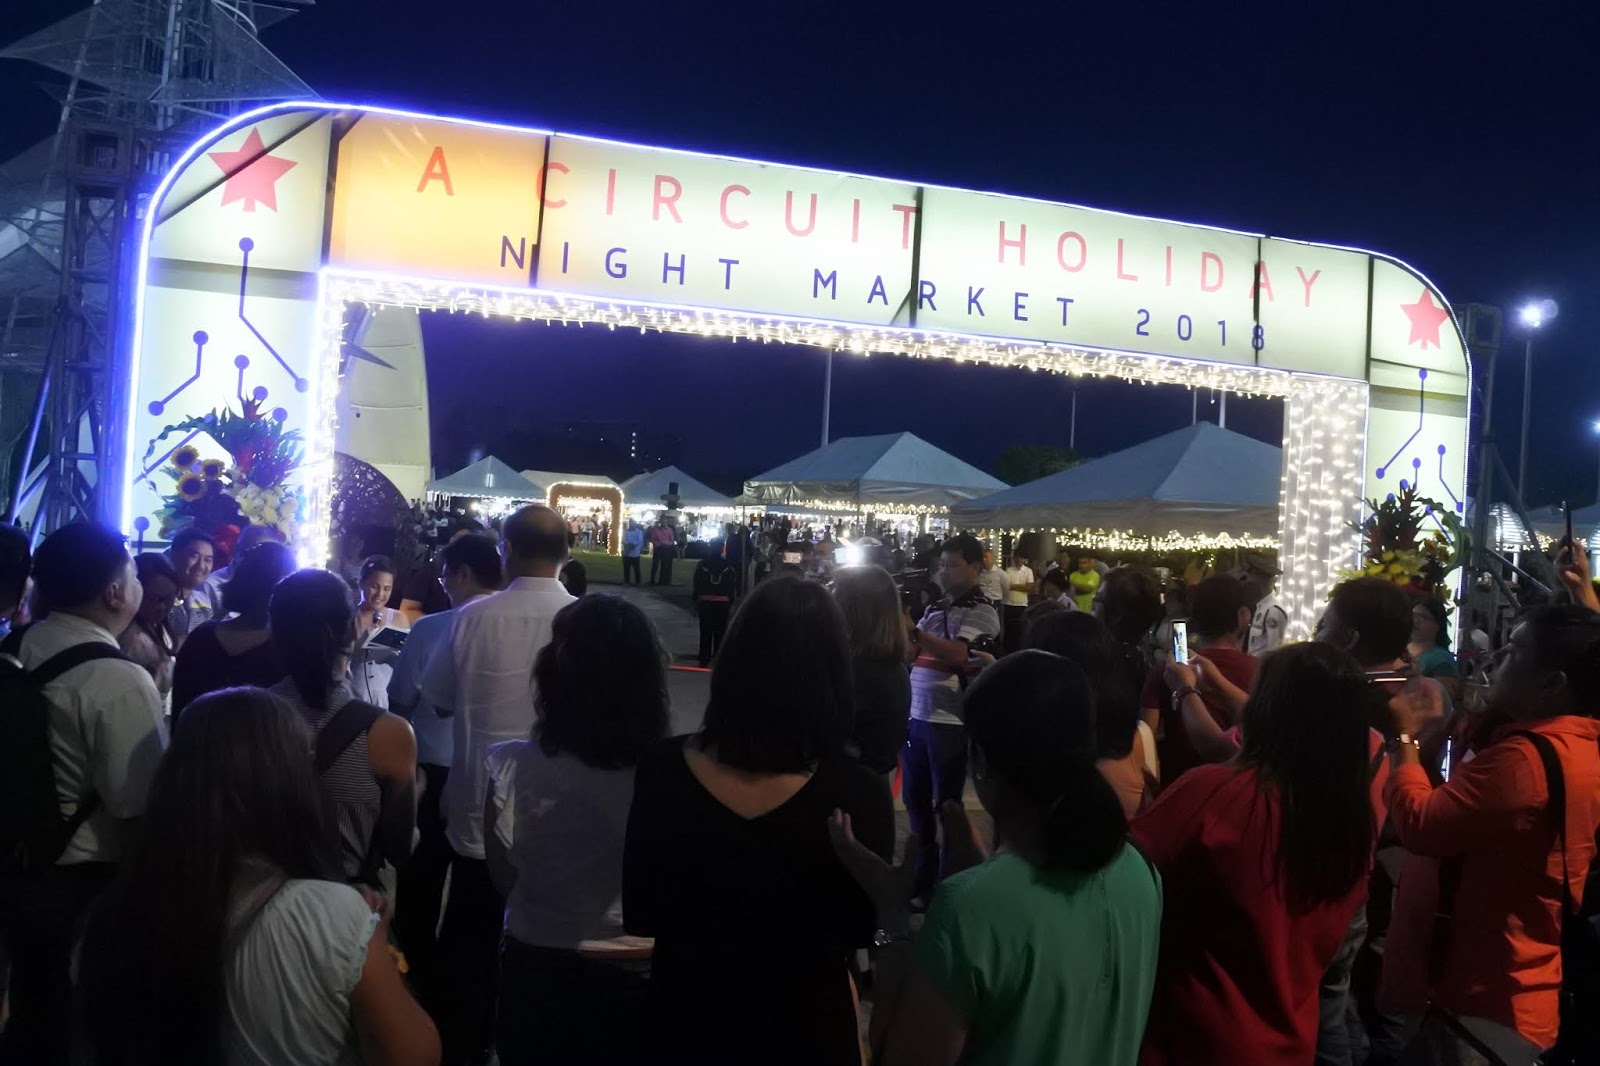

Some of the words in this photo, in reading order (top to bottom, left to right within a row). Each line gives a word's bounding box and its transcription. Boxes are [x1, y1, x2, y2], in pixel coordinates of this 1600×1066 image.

[416, 146, 455, 197] A
[536, 161, 920, 249] CIRCUIT
[997, 220, 1322, 307] HOLIDAY
[500, 235, 740, 290] NIGHT
[812, 268, 1075, 327] MARKET
[1135, 308, 1266, 351] 2018
